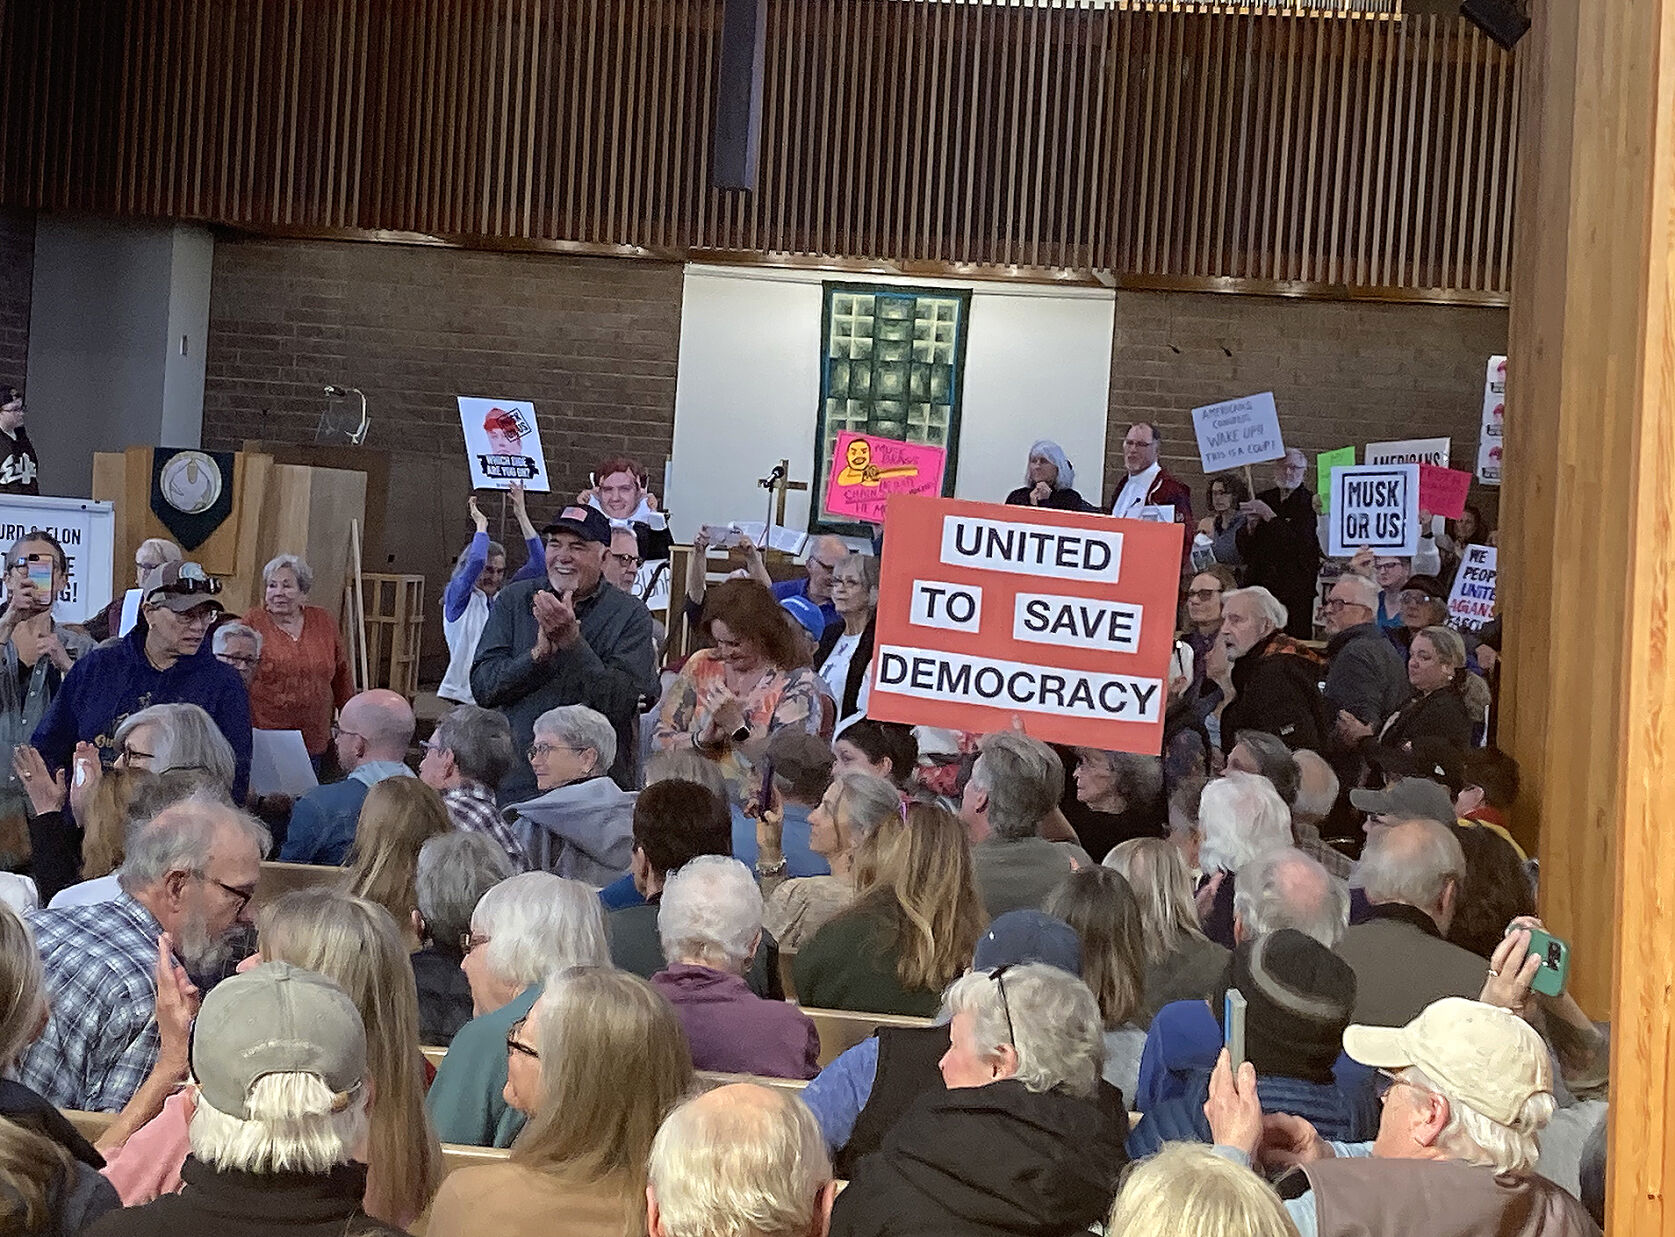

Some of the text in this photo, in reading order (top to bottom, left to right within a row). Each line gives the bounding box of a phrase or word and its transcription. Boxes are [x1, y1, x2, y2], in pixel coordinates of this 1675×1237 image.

[1206, 429, 1240, 448] WAKE
[1205, 451, 1226, 465] THIS
[1348, 480, 1400, 508] MUSK
[1346, 512, 1401, 539] OR US
[955, 523, 1112, 571] UNITED
[1470, 549, 1489, 563] WE
[920, 587, 1135, 644] TO SAVE
[880, 652, 1158, 715] DEMOCRACY
